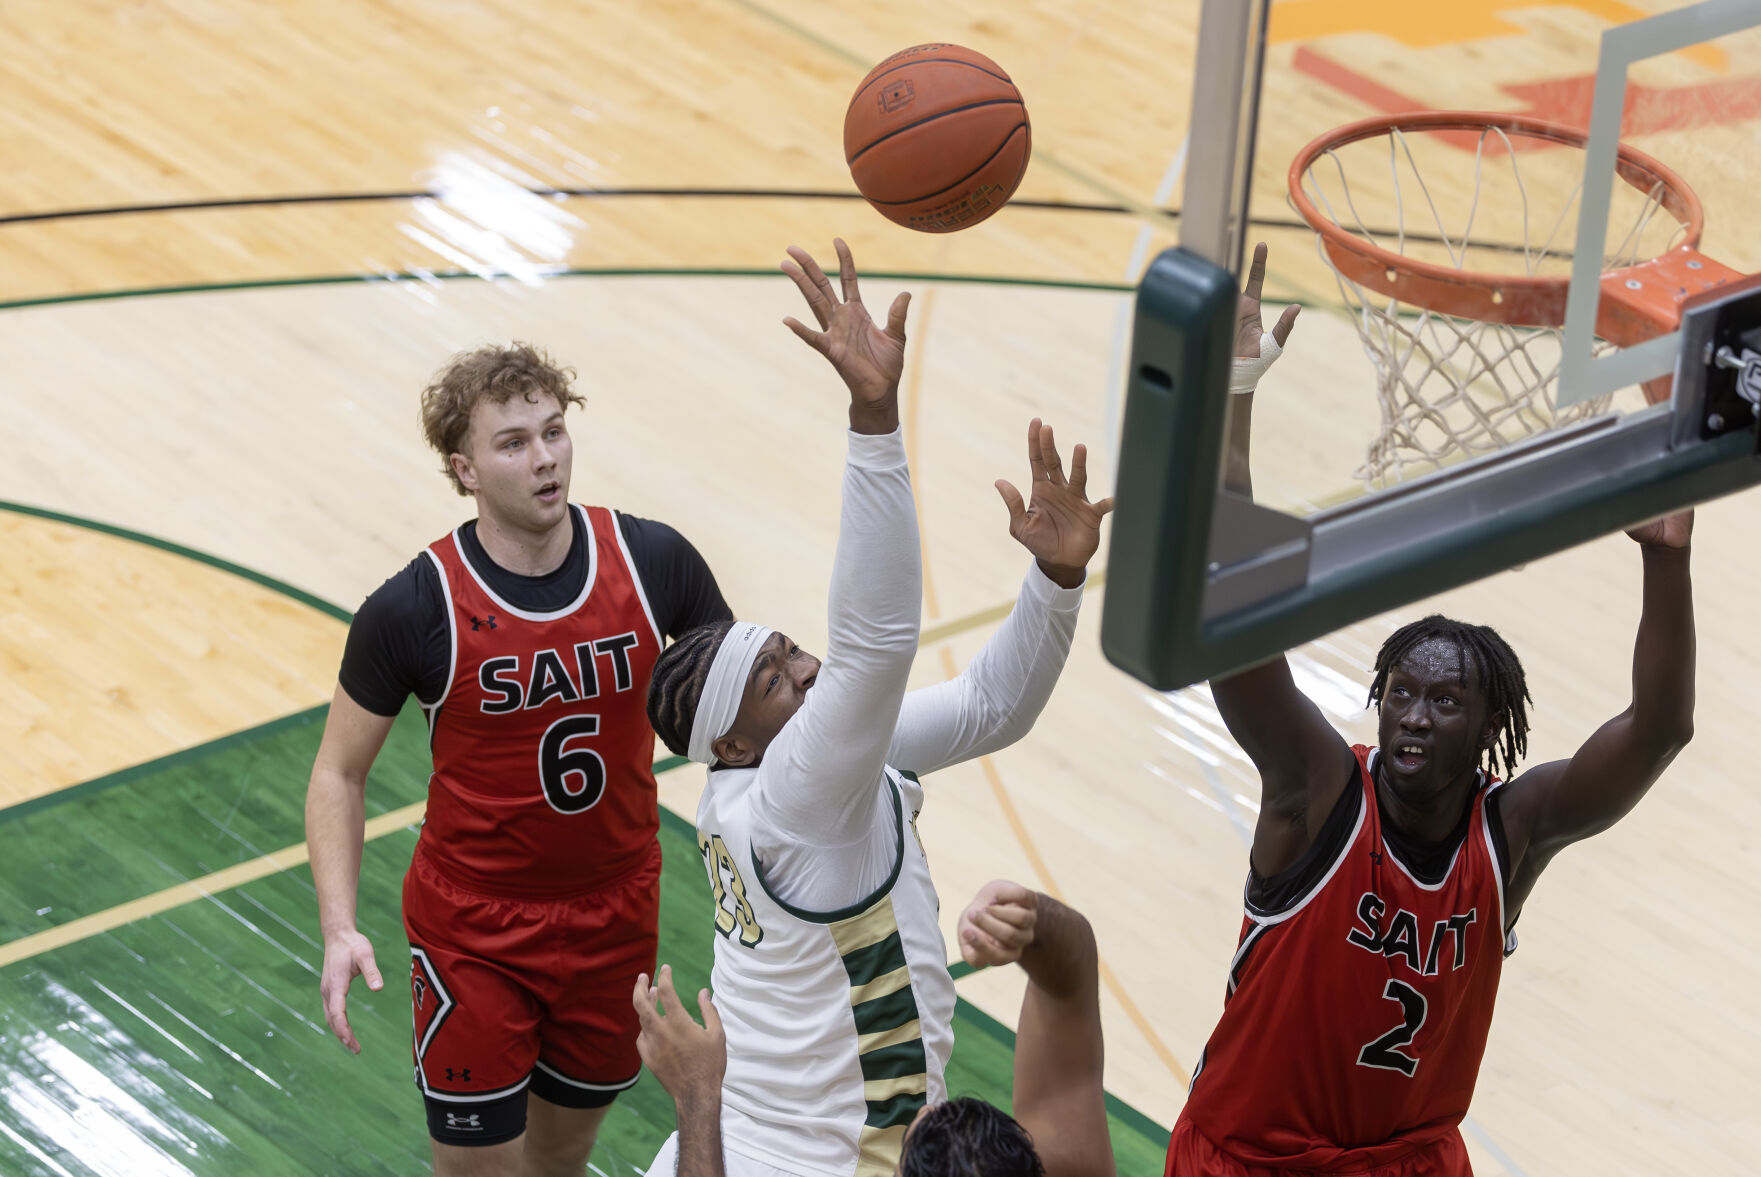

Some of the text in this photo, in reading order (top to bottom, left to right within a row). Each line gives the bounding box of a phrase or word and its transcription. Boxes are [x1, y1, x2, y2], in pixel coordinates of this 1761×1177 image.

[478, 631, 639, 715] SAIT
[538, 713, 607, 815] 6
[1346, 891, 1477, 977] SAIT
[1356, 978, 1428, 1078] 2
